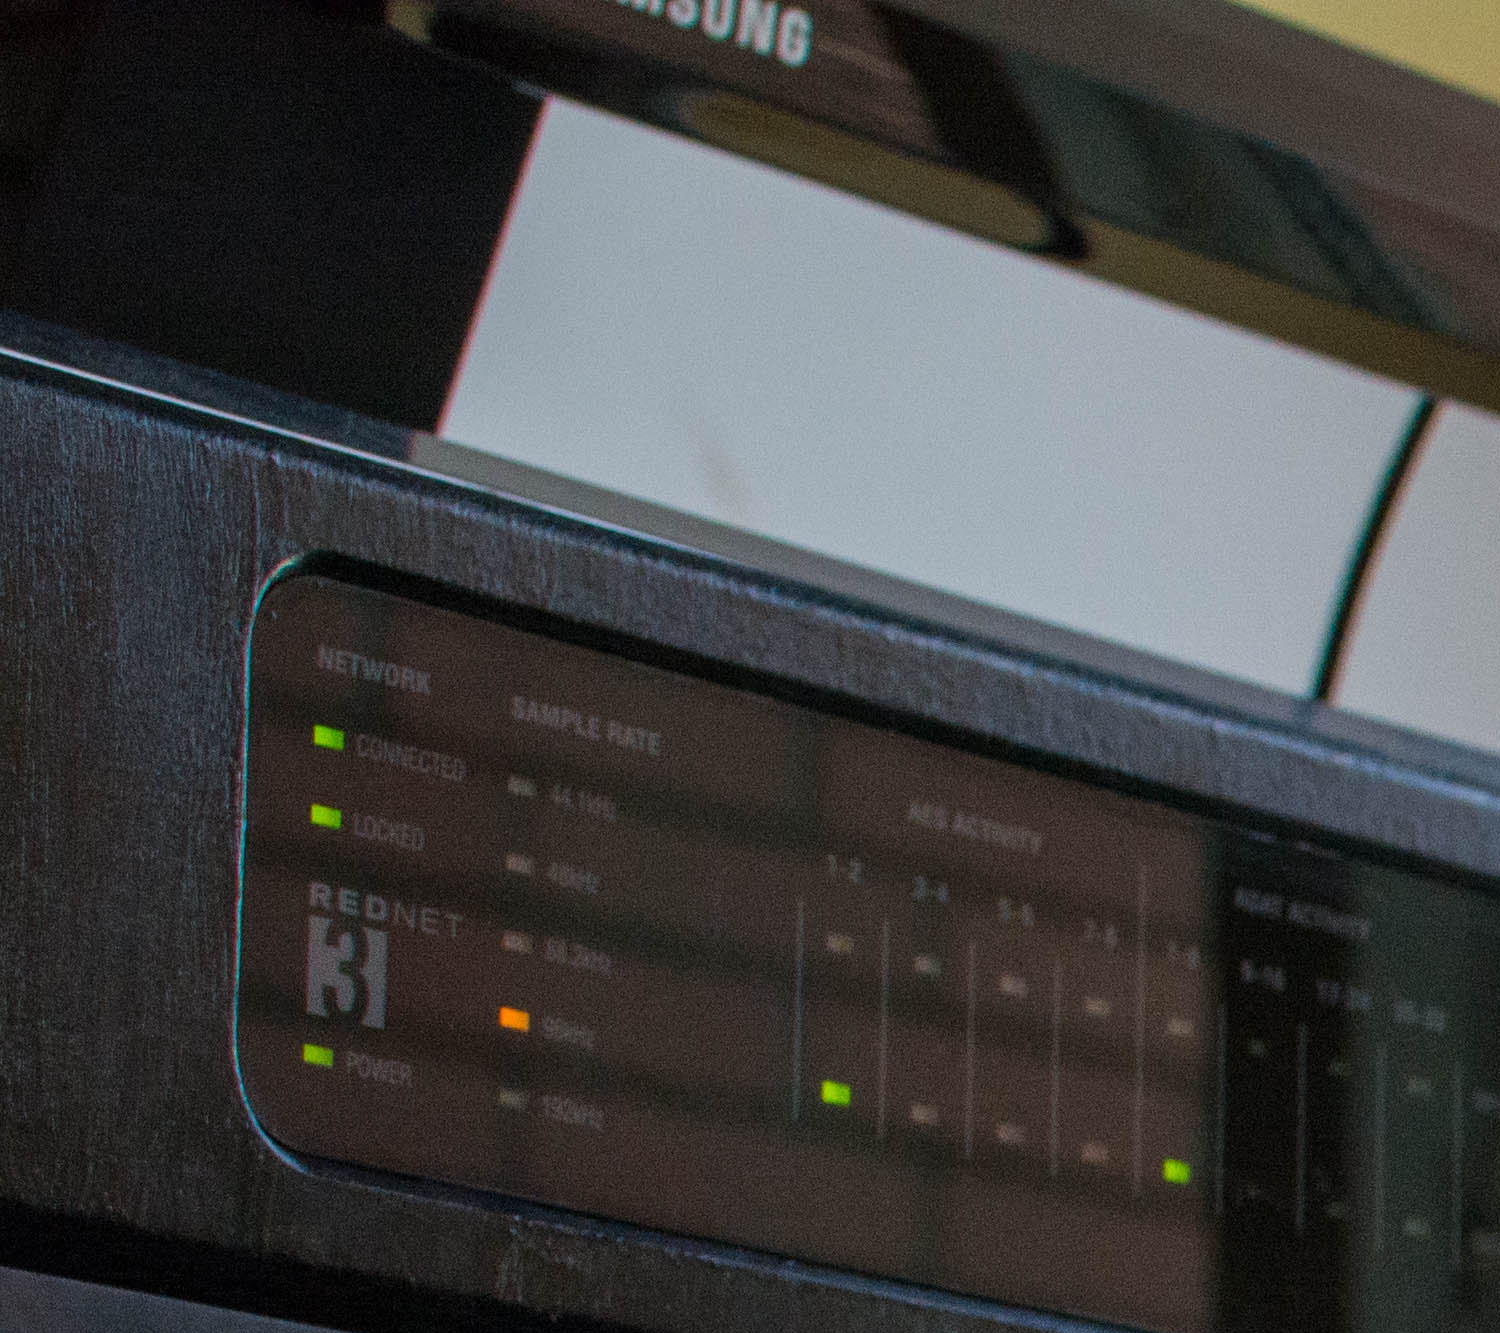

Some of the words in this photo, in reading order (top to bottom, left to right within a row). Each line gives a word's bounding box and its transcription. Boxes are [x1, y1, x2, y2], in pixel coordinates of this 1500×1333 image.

[317, 645, 431, 695] NETWORK
[511, 695, 601, 742] SAMPLE
[607, 719, 661, 756] RATE
[356, 733, 466, 782] CONNECTED
[353, 811, 425, 851] LOCKED
[308, 881, 464, 938] REDNET
[346, 1049, 413, 1088] POWER
